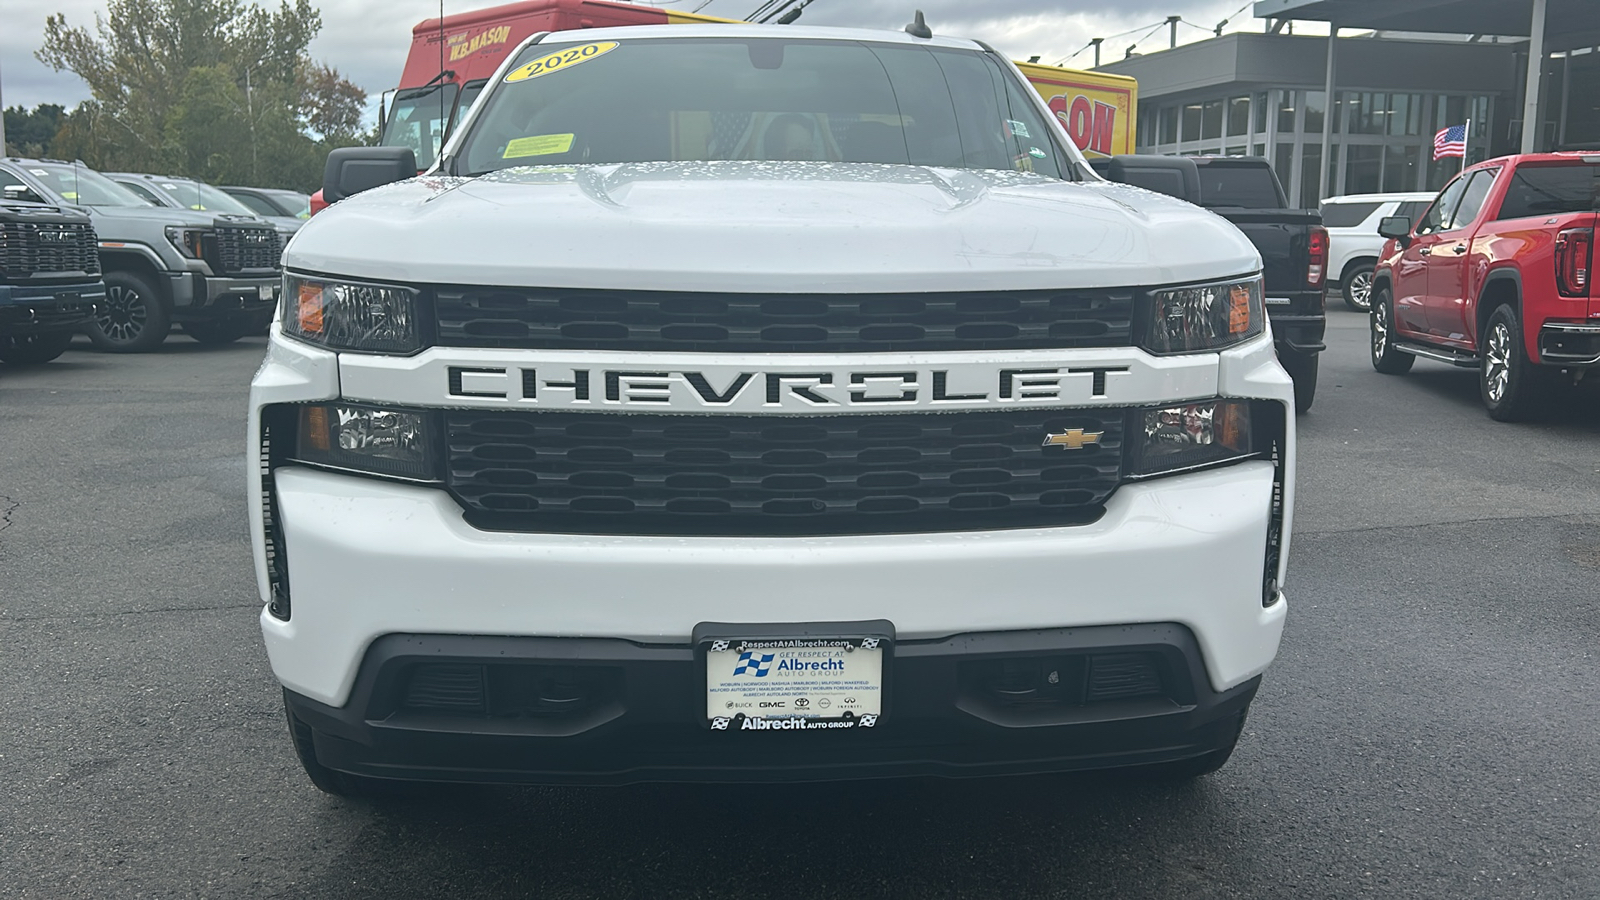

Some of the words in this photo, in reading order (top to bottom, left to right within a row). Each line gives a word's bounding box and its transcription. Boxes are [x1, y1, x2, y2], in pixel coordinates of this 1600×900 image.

[527, 45, 599, 77] 2020
[447, 366, 1133, 406] CHEVROLET
[741, 639, 850, 649] RespectAtAlbrecht.com
[777, 658, 845, 671] Albrecht
[741, 717, 807, 730] Albrecht
